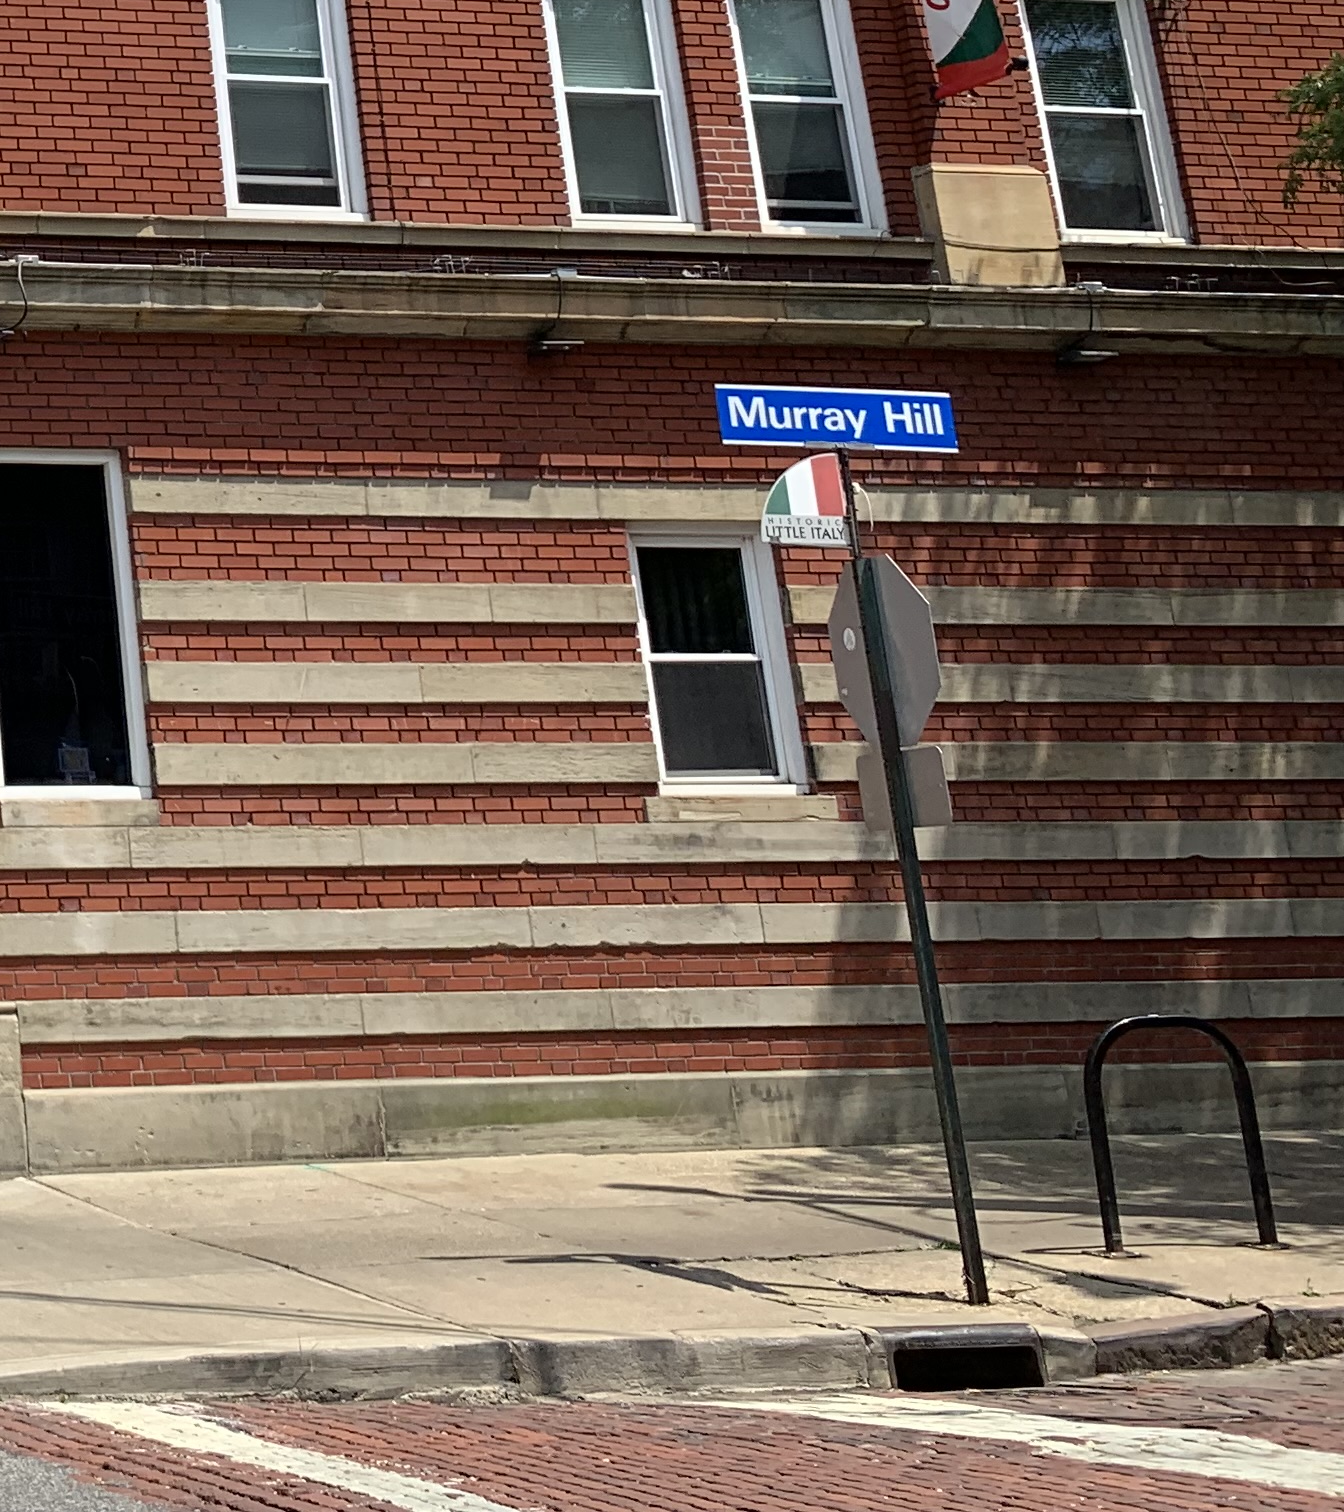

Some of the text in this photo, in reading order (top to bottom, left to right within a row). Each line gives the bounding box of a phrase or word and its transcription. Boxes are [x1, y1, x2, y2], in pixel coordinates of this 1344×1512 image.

[727, 395, 945, 439] Murray Hill
[767, 517, 841, 527] HISTORIC
[765, 526, 844, 540] LITTLE ITALY
